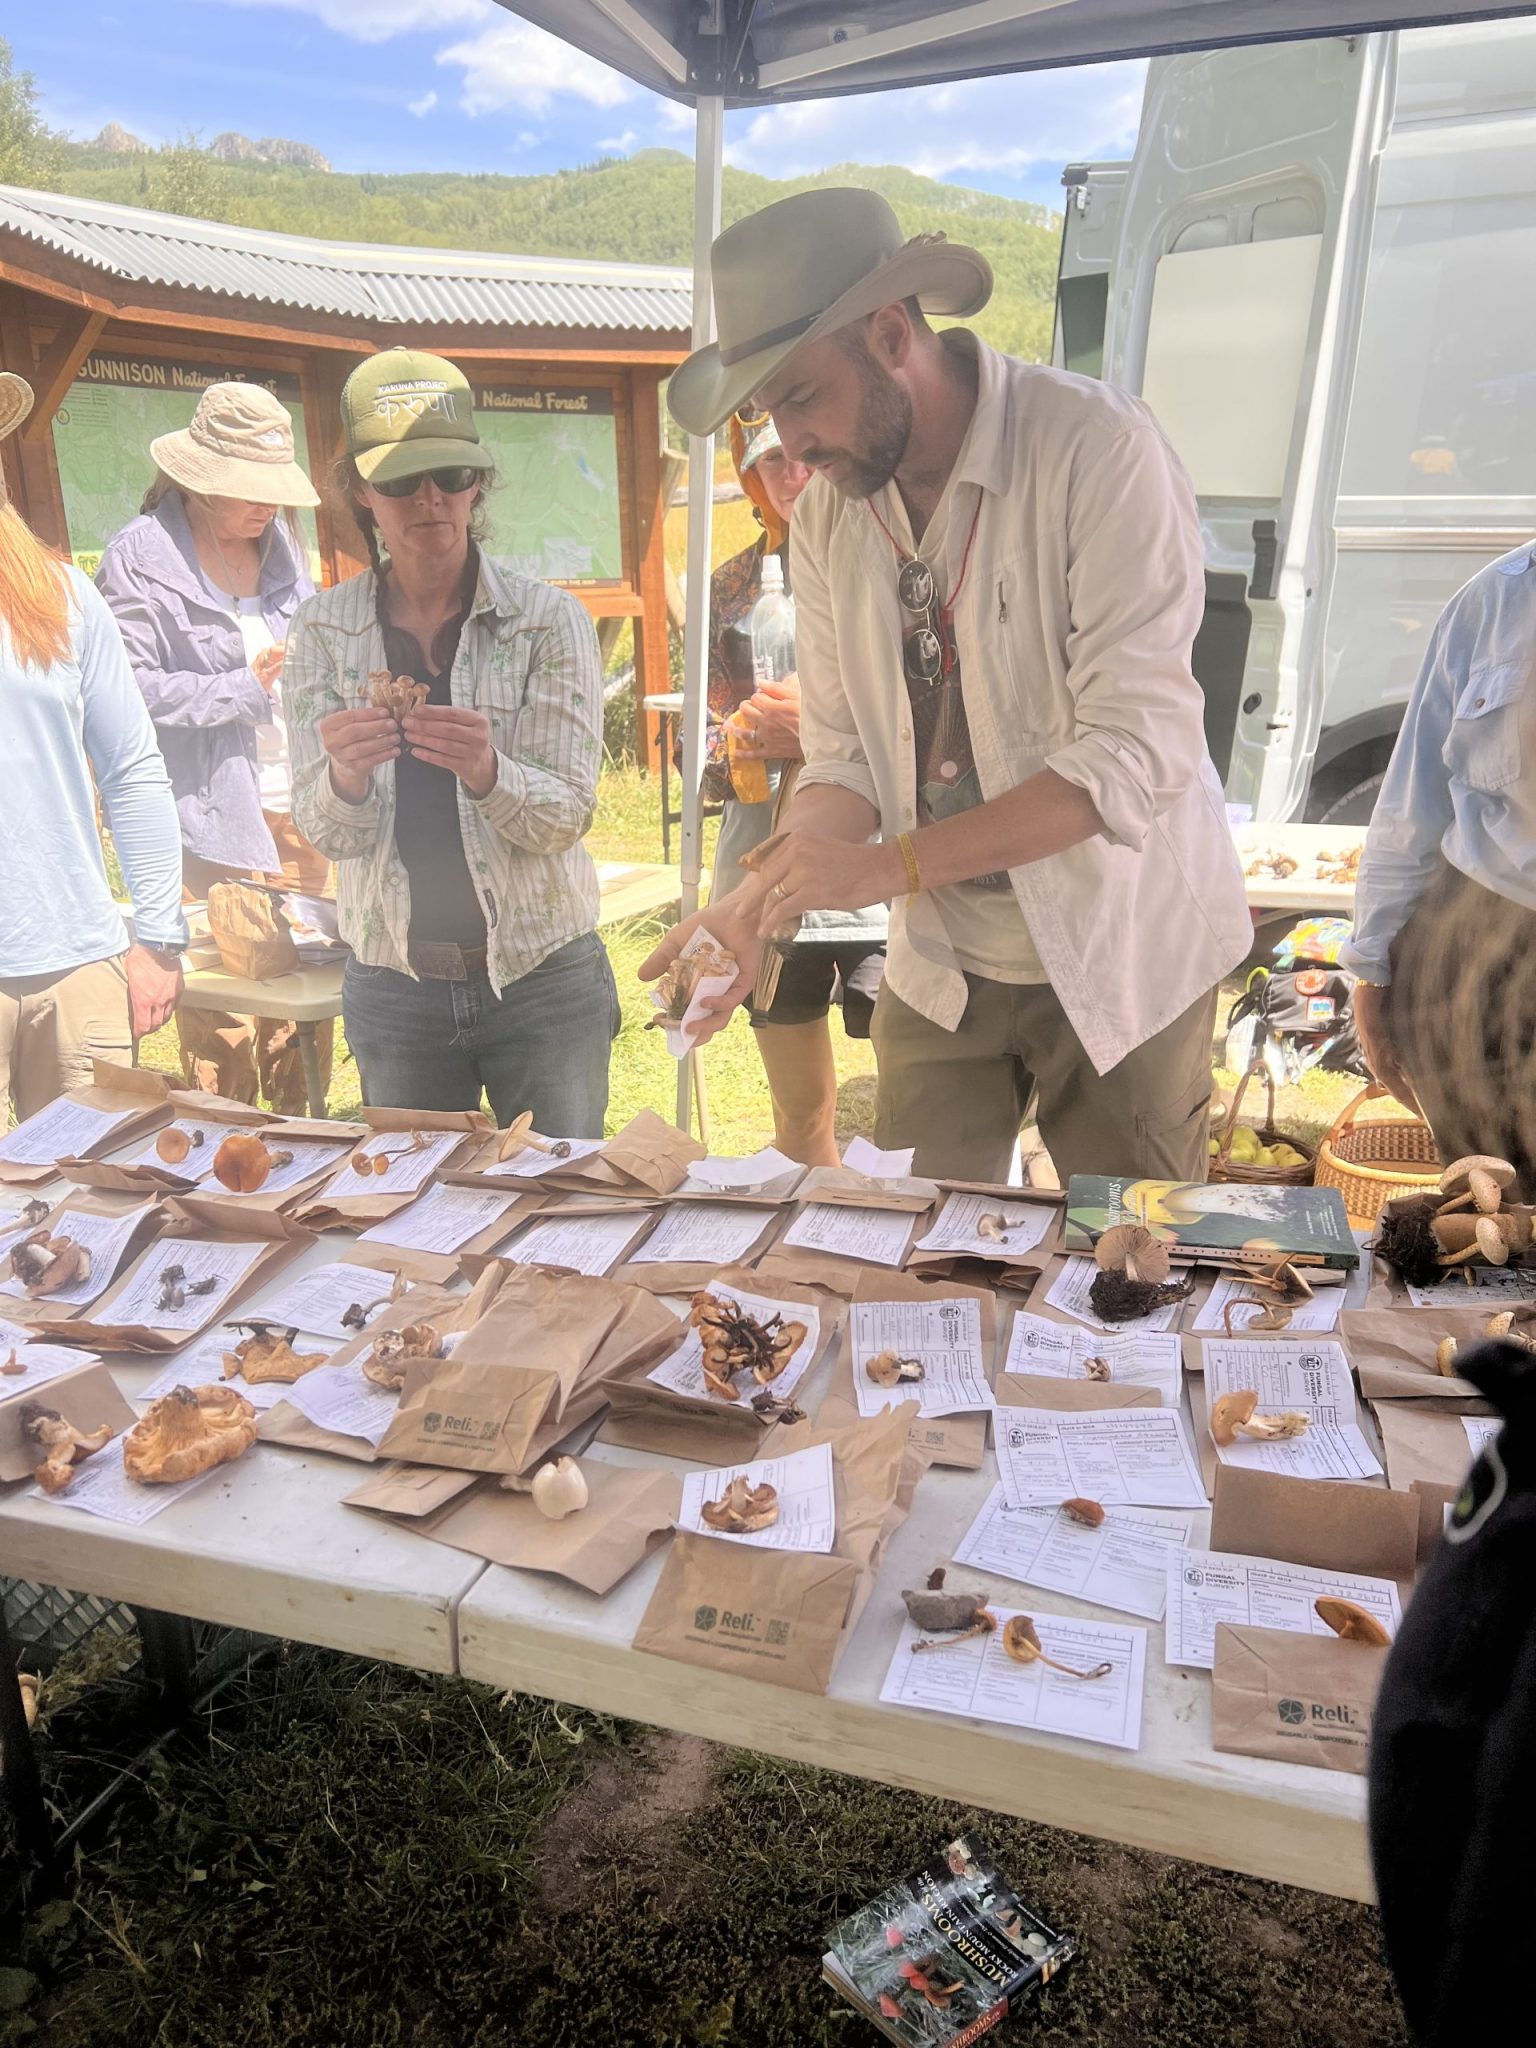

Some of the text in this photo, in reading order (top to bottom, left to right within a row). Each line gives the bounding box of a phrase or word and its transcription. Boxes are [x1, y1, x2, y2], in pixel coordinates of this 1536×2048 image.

[78, 358, 166, 384] GUNNISON
[415, 381, 448, 390] PROJECT
[483, 390, 542, 409] National
[544, 392, 588, 410] Forest
[1309, 1371, 1317, 1404] DIVERSITY
[444, 1415, 472, 1432] Reli.
[721, 1610, 755, 1632] Reli.
[1311, 1703, 1355, 1725] Reli.
[922, 1870, 949, 1909] REGION
[922, 1892, 1010, 1987] MUSHROOMS
[945, 1907, 993, 1955] MOUNTAIN
[986, 1953, 1019, 1979] ROCKY
[949, 2014, 992, 2048] SHROOMS
